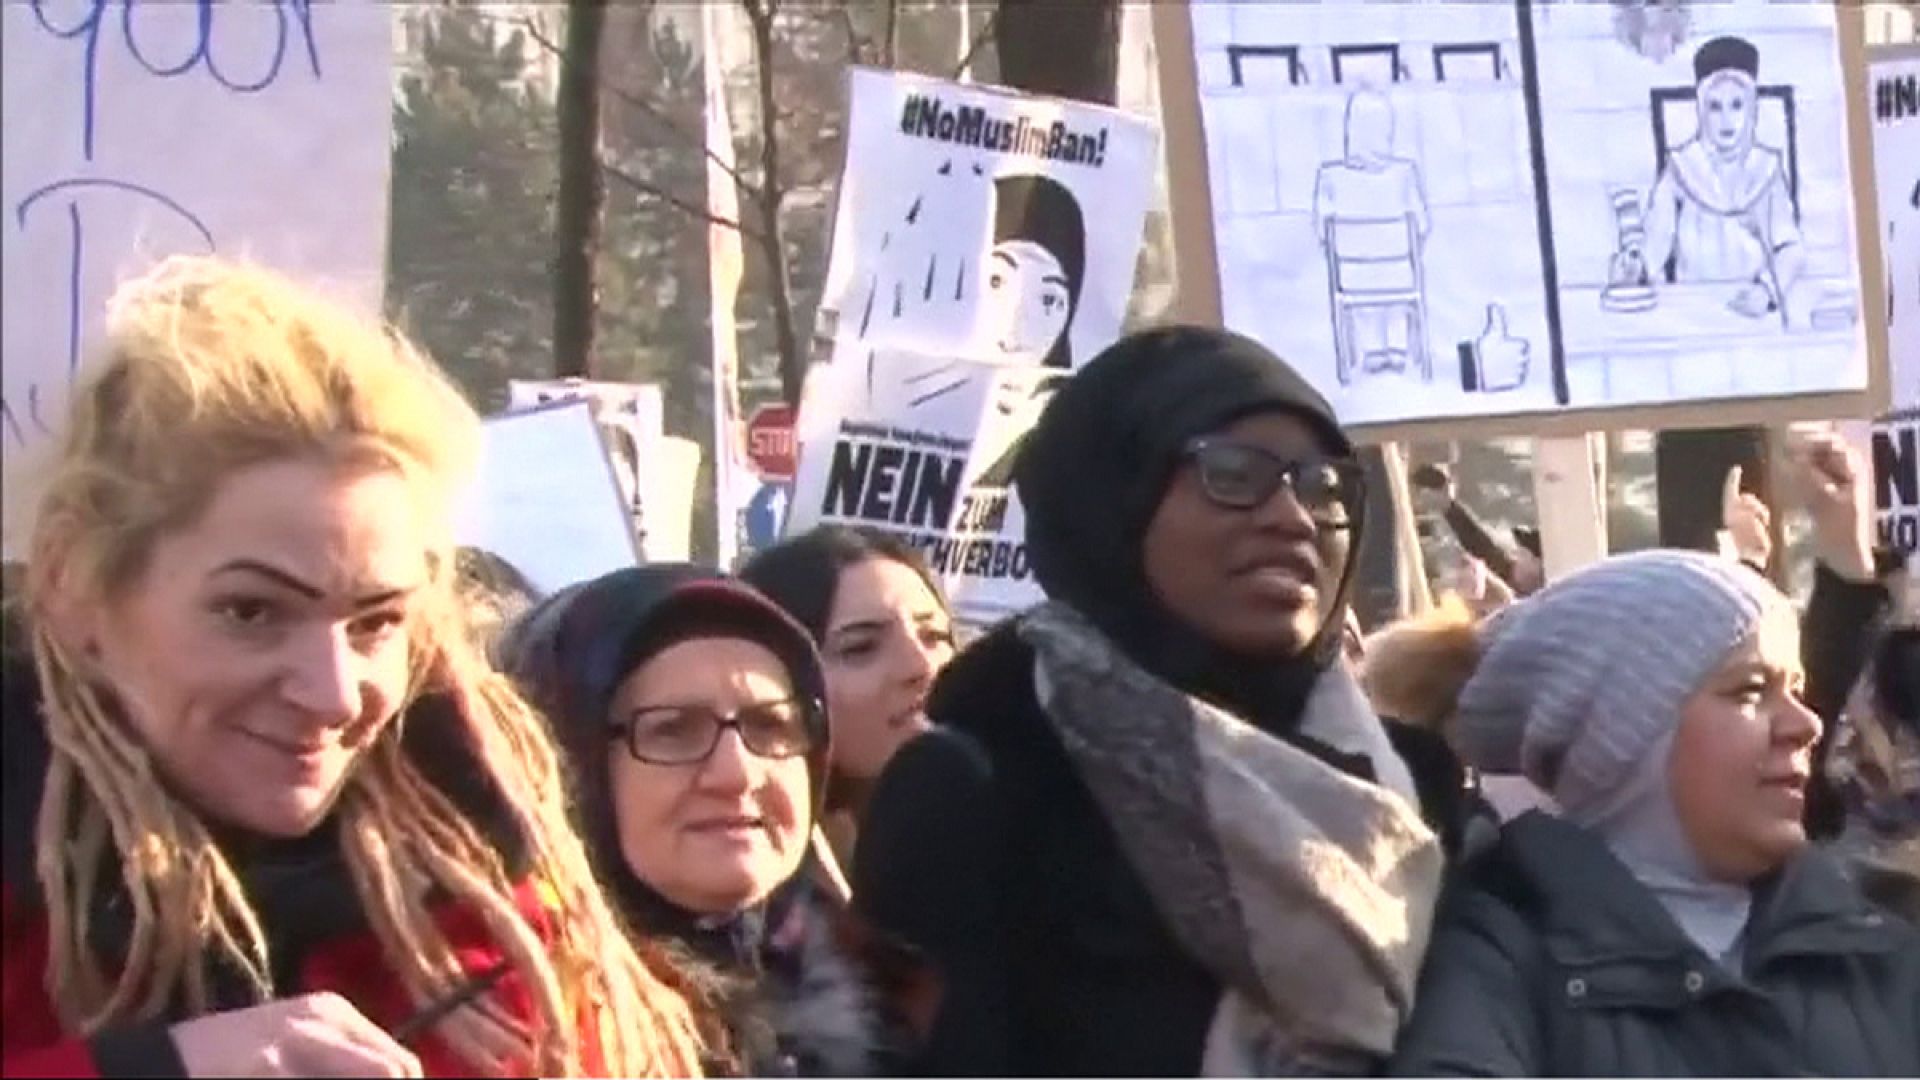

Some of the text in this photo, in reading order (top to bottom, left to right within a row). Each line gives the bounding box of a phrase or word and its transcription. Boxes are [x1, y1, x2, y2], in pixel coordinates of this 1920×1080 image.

[1876, 74, 1920, 120] #N
[900, 94, 1107, 167] #NoMuslimBan!
[751, 427, 795, 456] STO
[822, 440, 966, 529] NEIN
[955, 495, 1008, 531] ZUM
